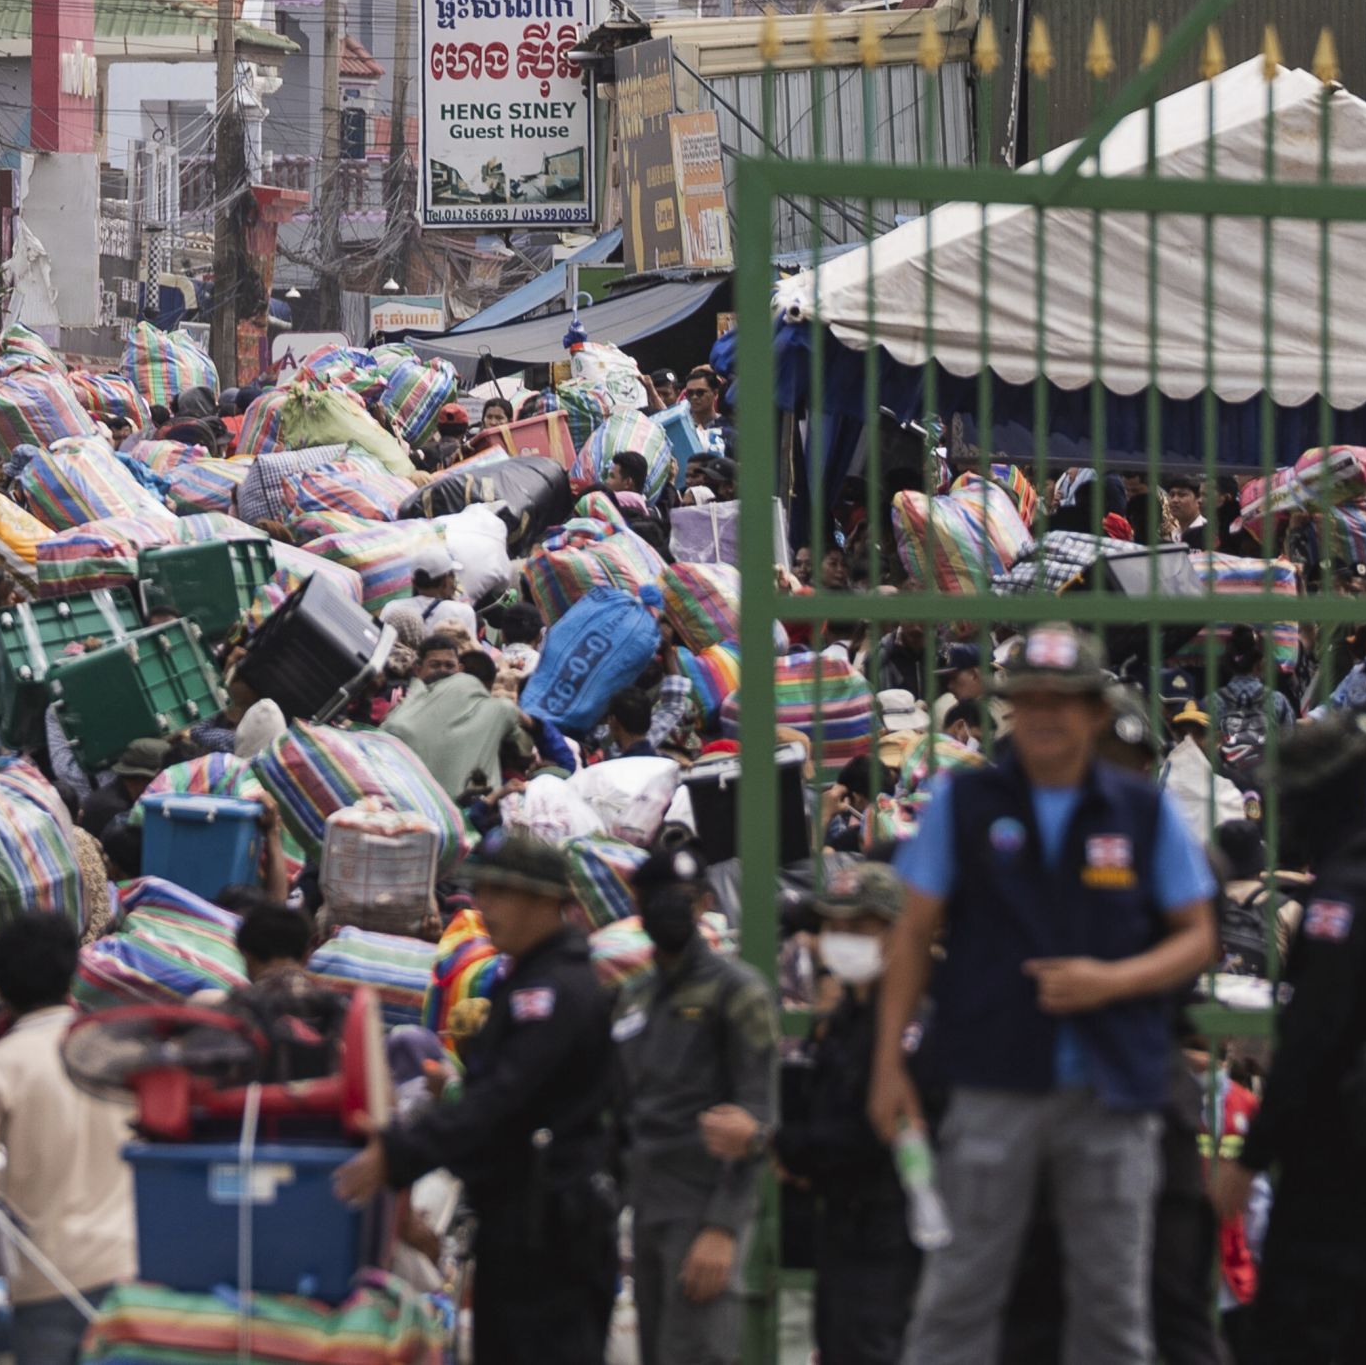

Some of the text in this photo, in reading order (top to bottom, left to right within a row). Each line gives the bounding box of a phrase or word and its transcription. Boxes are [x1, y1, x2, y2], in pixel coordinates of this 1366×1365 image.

[440, 102, 577, 121] HENG SINEY
[449, 124, 570, 139] Guest House
[546, 634, 608, 713] 46-0-0
